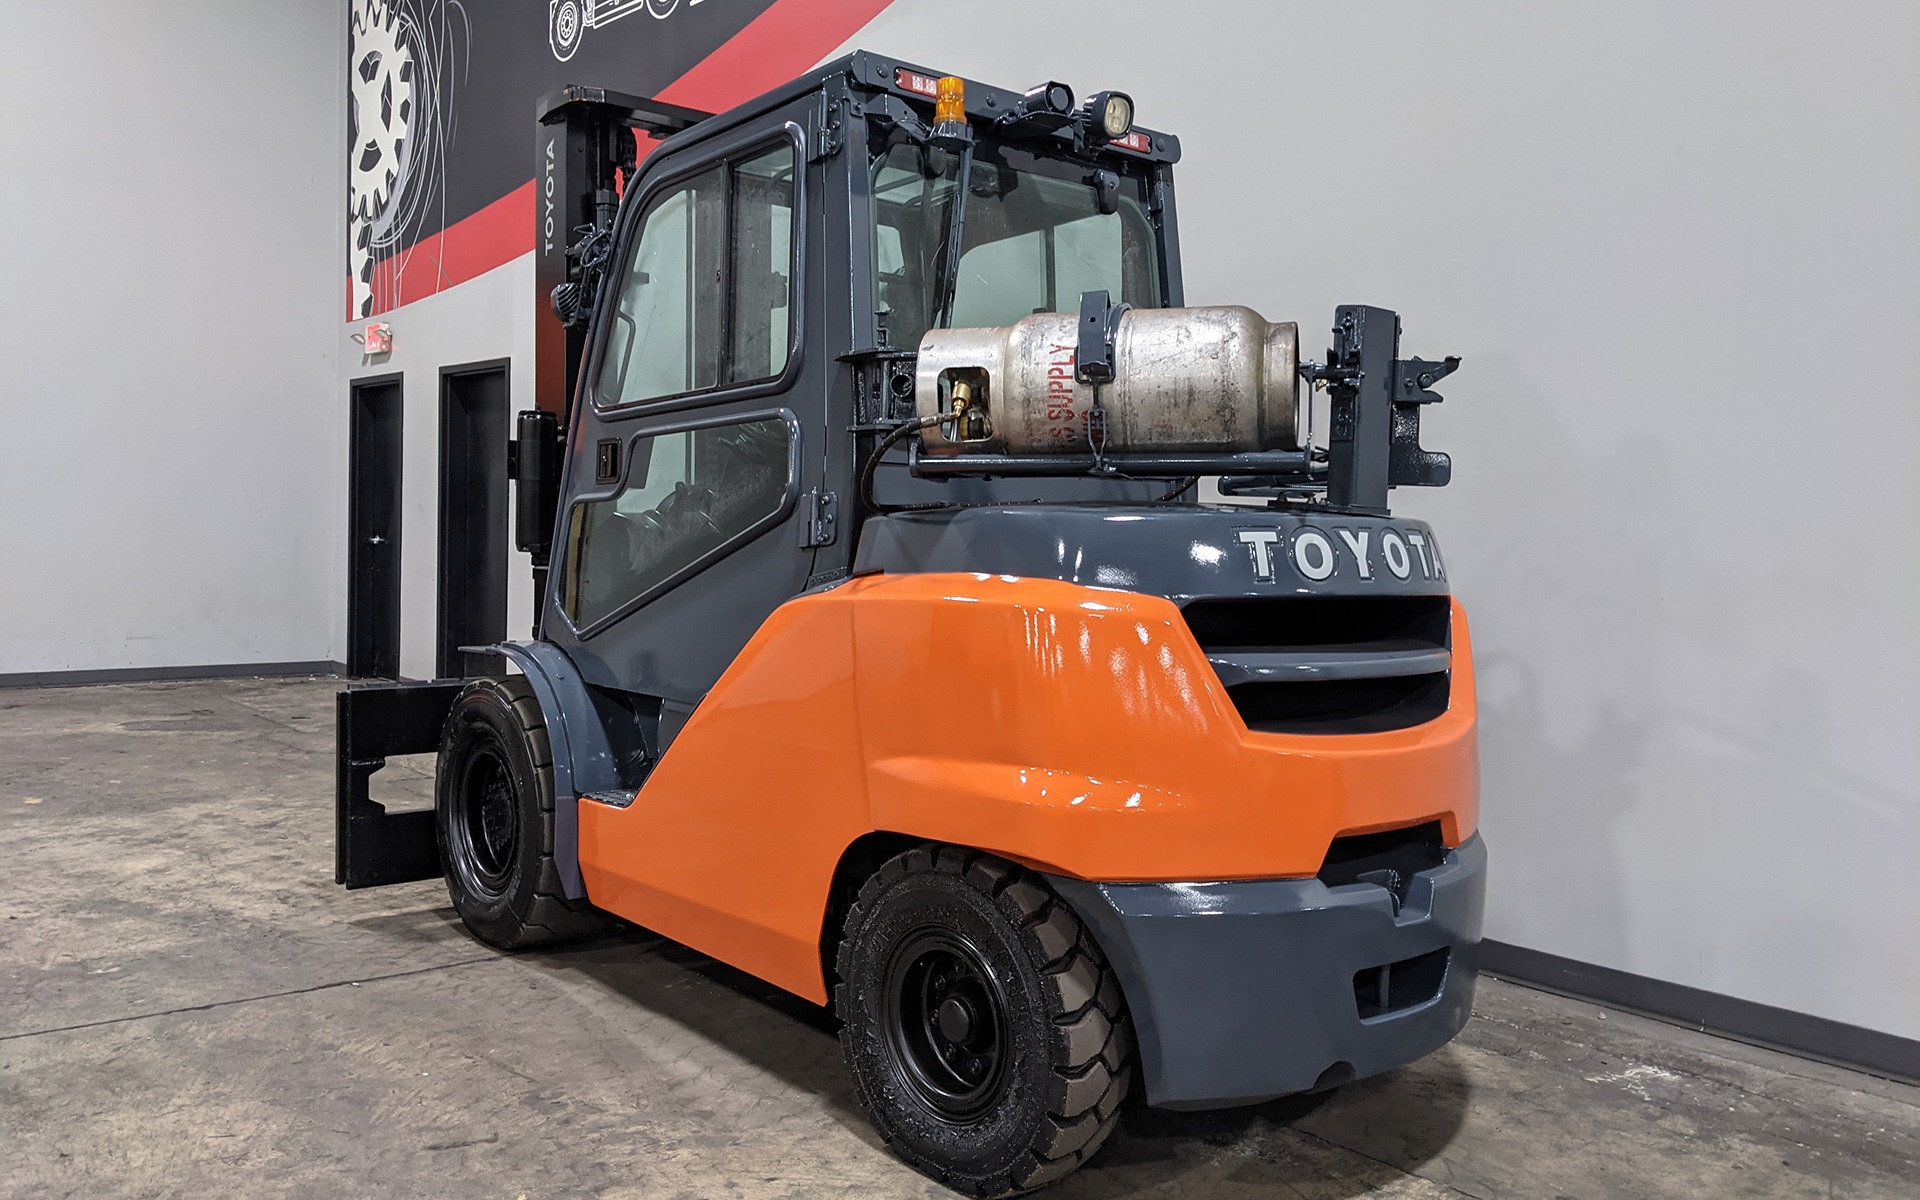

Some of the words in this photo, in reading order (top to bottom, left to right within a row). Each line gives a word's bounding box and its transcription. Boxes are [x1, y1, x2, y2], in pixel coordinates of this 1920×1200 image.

[544, 137, 555, 257] TOYOTA
[1047, 343, 1075, 421] SUPPLY
[1238, 530, 1447, 583] TOYOTA
